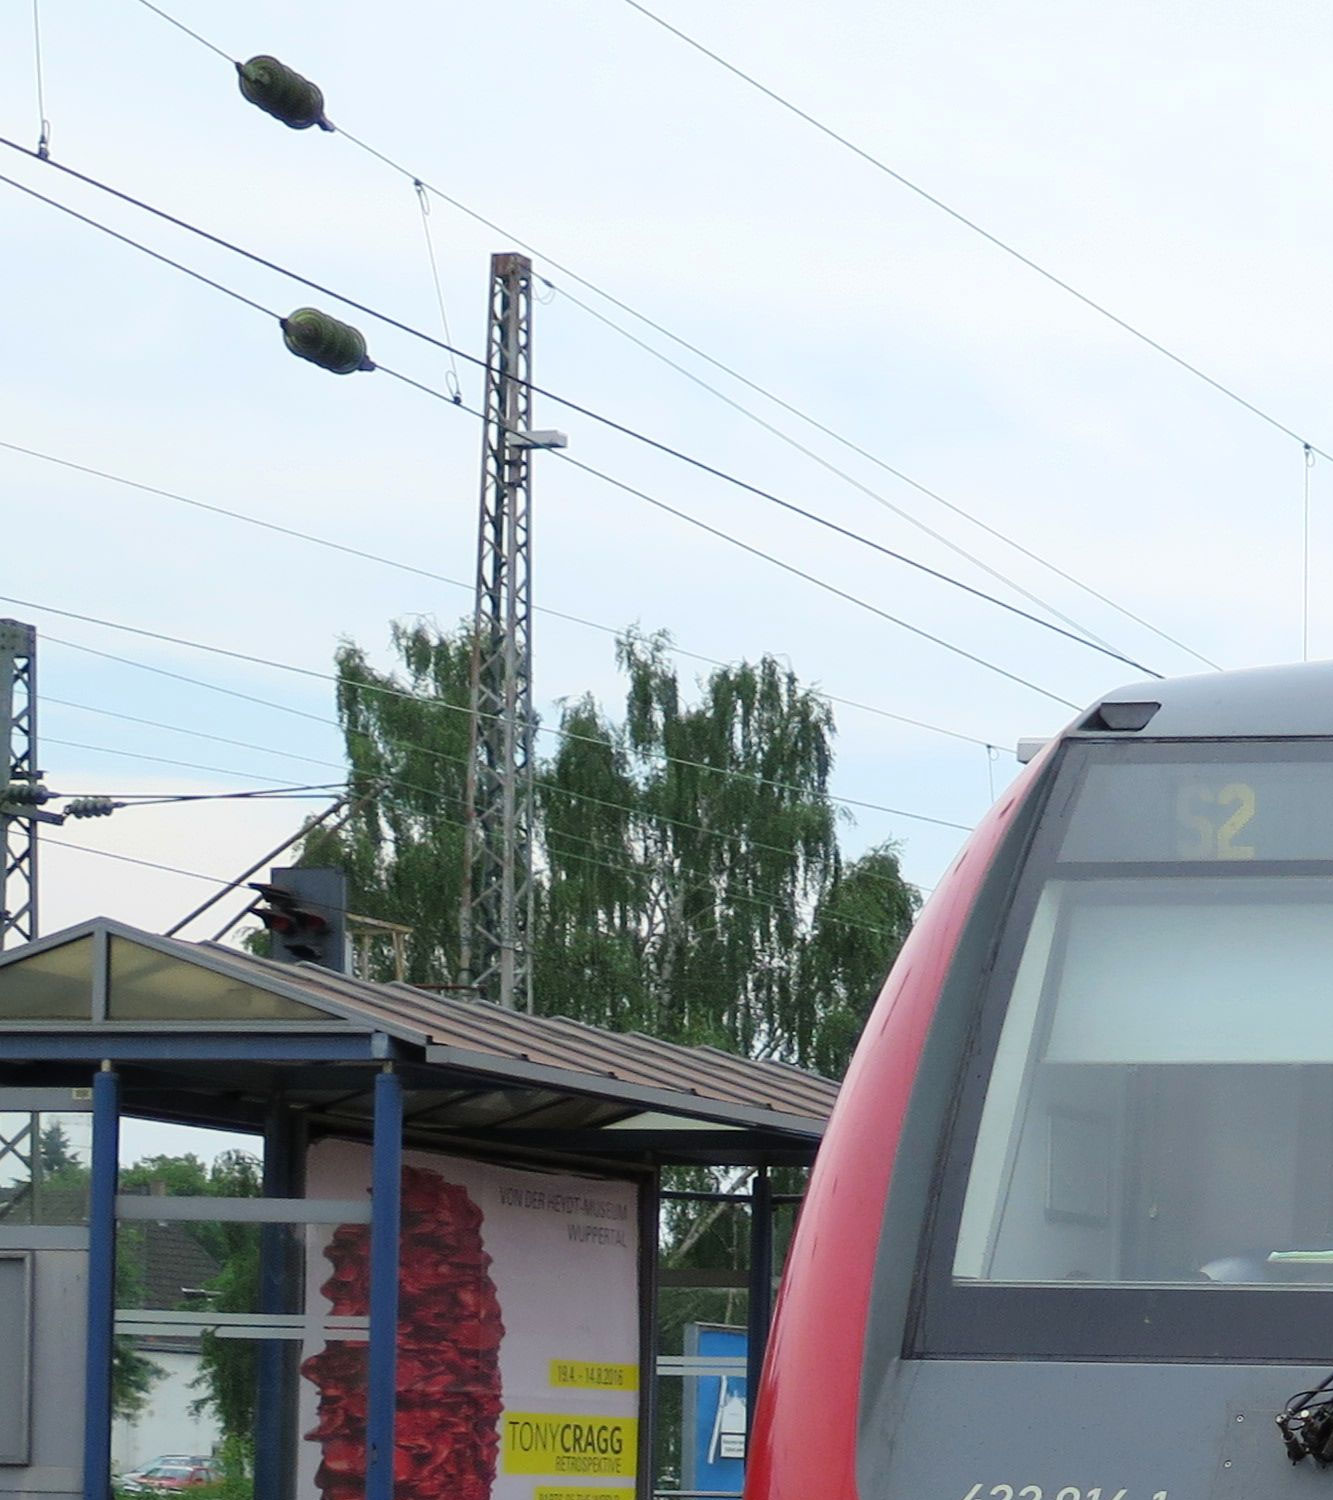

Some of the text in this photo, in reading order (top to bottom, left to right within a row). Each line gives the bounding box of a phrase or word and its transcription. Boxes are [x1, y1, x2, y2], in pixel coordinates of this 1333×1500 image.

[1177, 783, 1256, 859] S2
[567, 1224, 627, 1248] WUPPERTAL
[555, 1456, 622, 1473] RETROSPEKTIVE
